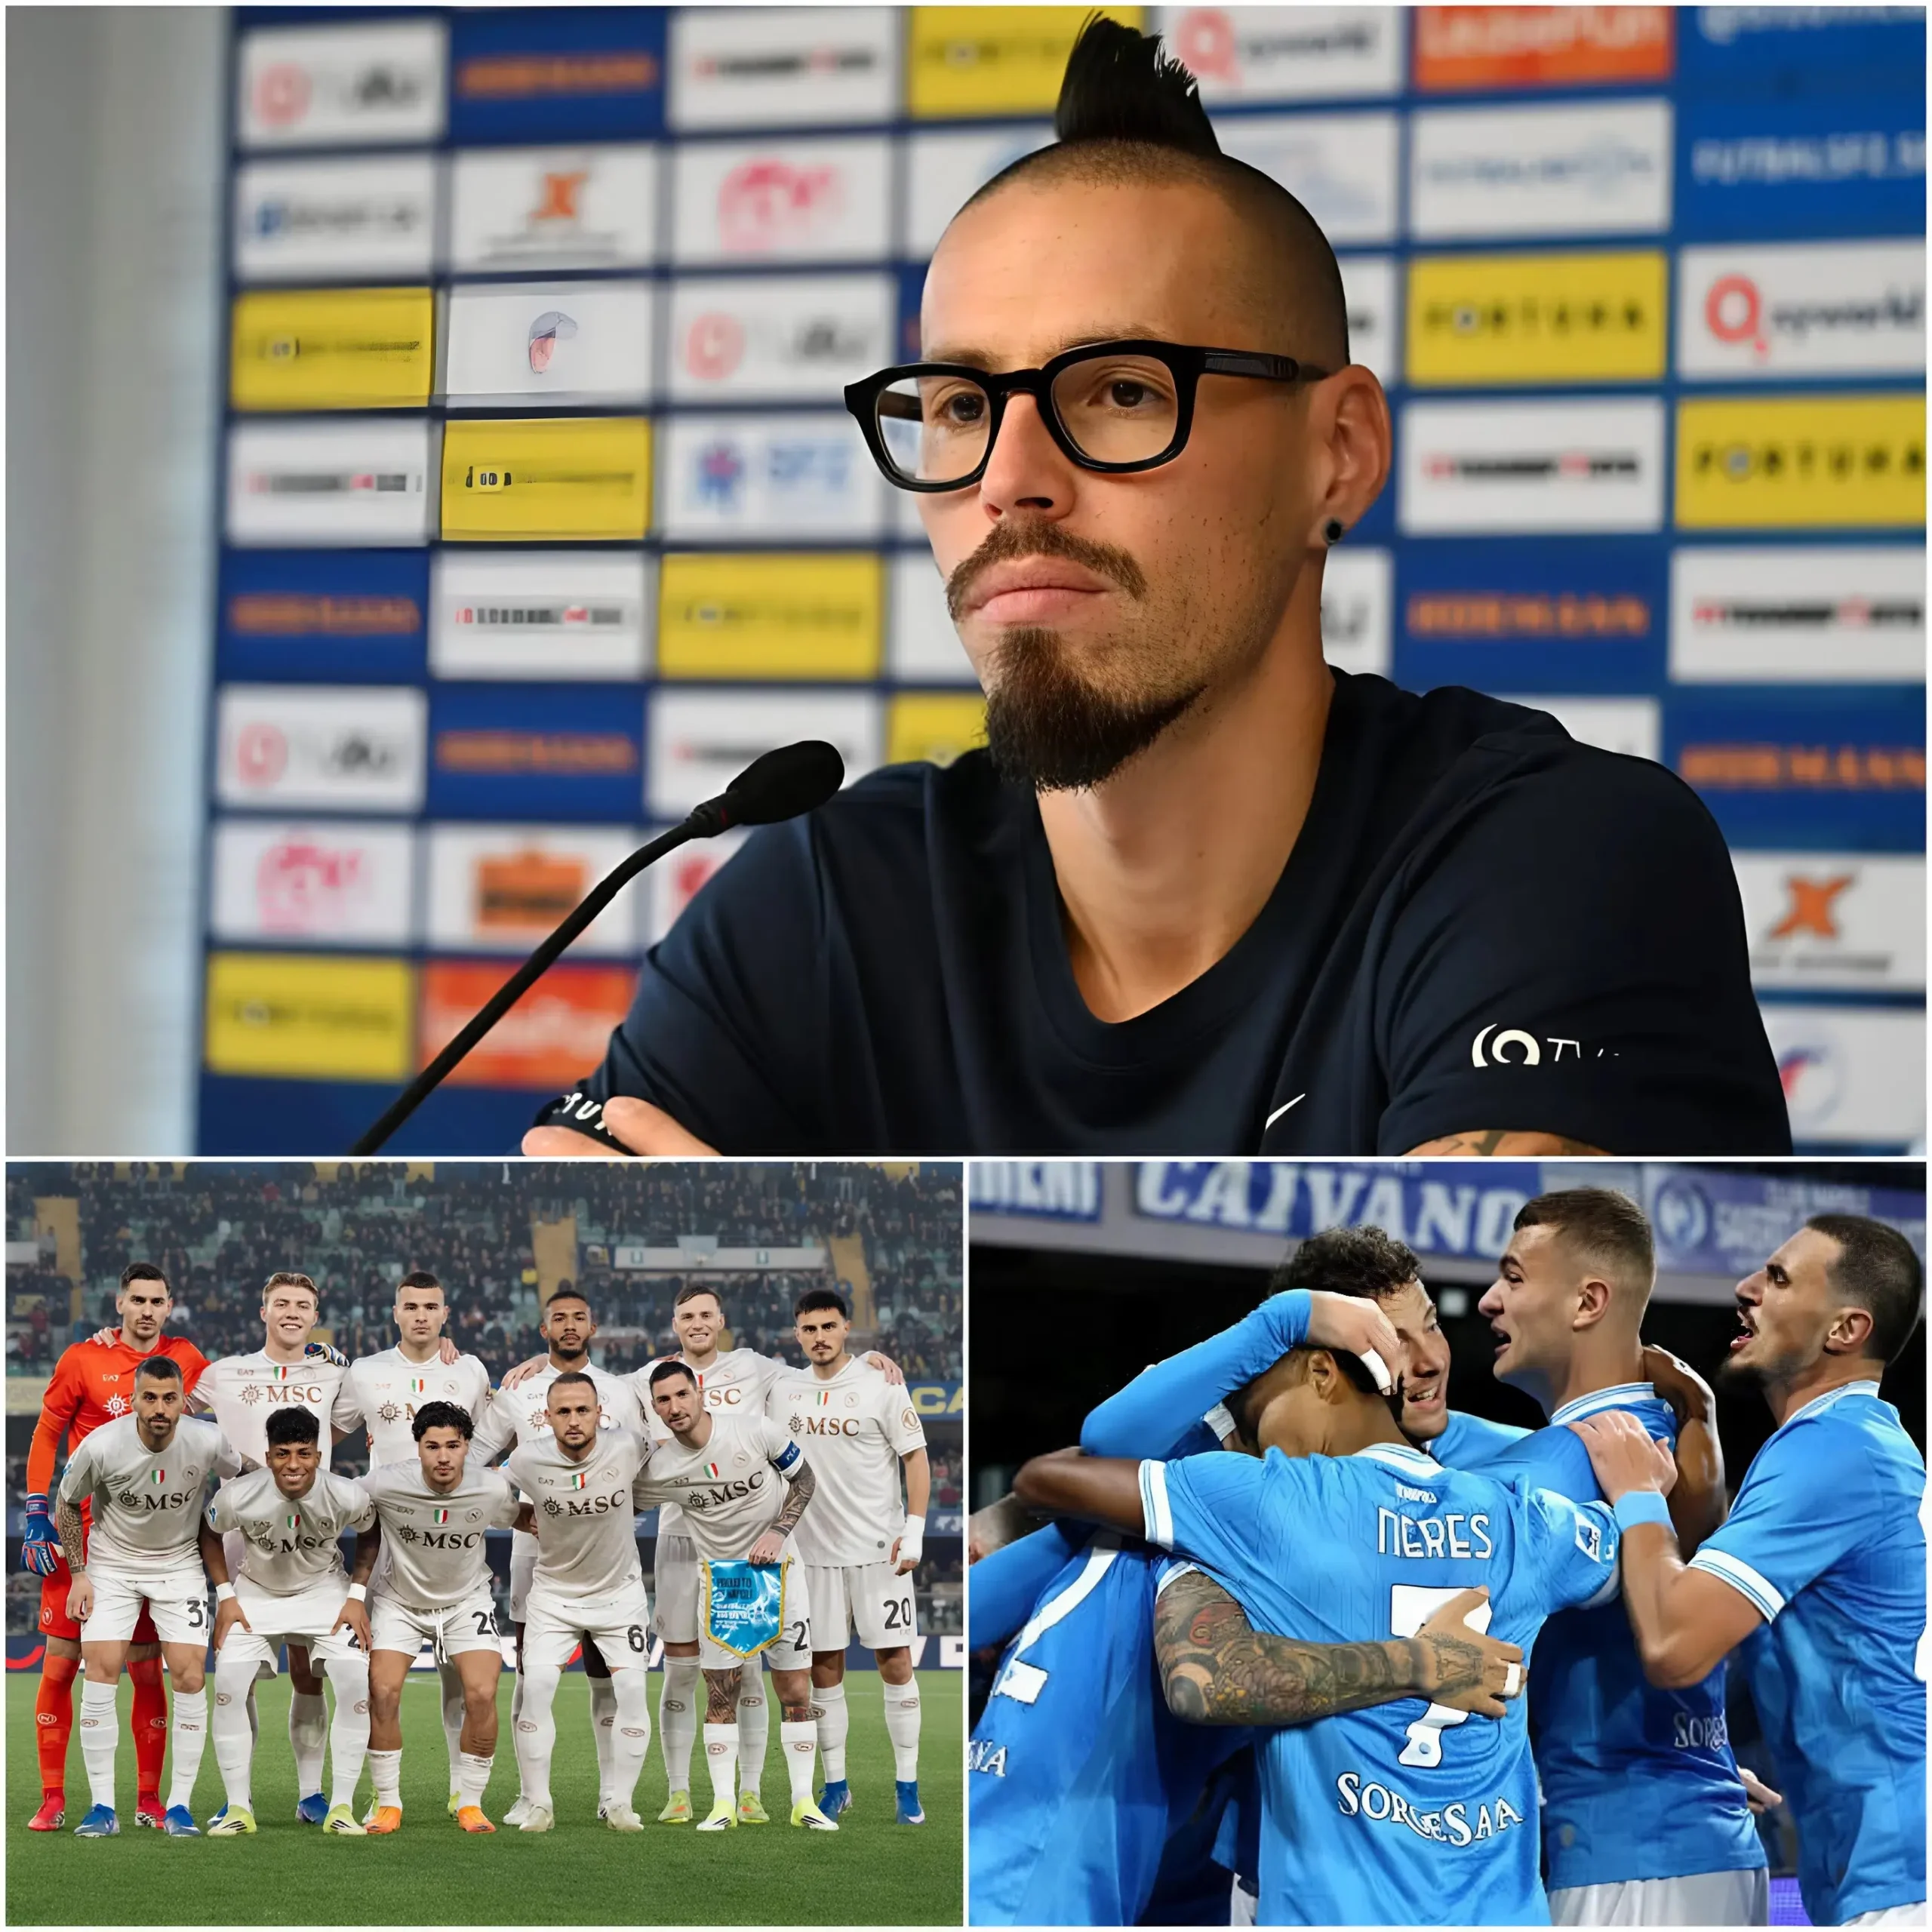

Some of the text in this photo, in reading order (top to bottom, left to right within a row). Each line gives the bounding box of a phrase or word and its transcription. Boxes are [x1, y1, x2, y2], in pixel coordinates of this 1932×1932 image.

[1138, 1162, 1526, 1259] CAIVANO
[266, 1385, 322, 1403] MSC
[699, 1389, 741, 1407] SC
[806, 1417, 860, 1437] MSC
[144, 1486, 198, 1510] MSC
[709, 1471, 764, 1506] MSC
[567, 1489, 626, 1517] MSC
[423, 1531, 481, 1550] MSC
[1377, 1504, 1493, 1560] NERES
[883, 1597, 911, 1630] 20
